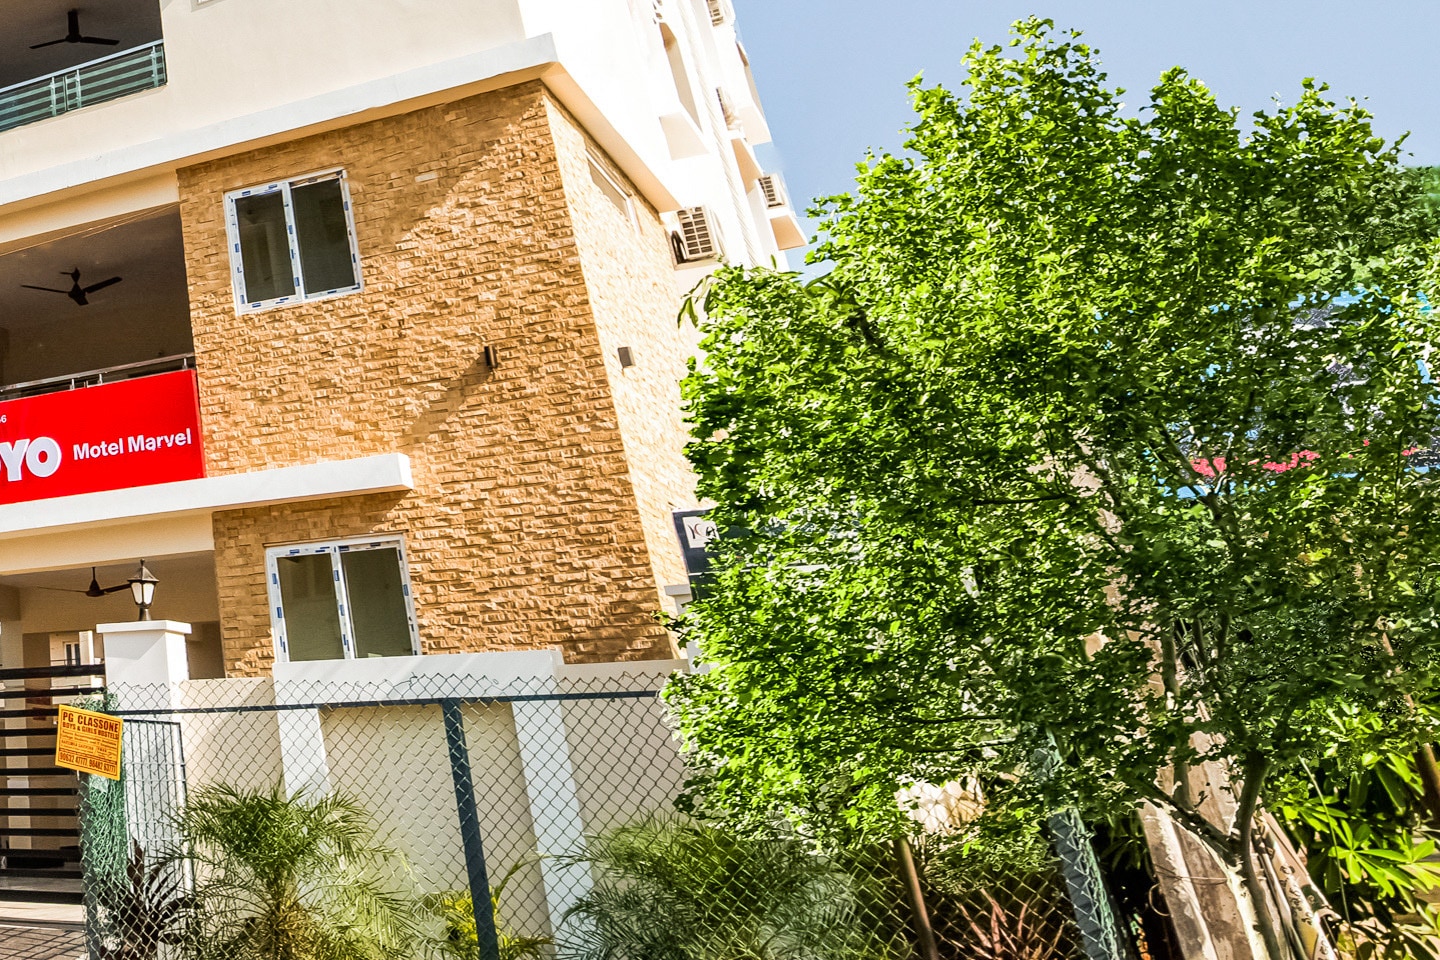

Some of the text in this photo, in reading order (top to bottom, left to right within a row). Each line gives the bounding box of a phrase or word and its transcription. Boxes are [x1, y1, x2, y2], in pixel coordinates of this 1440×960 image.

[73, 428, 192, 460] Motel Marvel
[62, 712, 118, 733] PG CLASSONE
[62, 722, 76, 730] BOYS
[81, 725, 97, 735] GIRLS
[97, 729, 119, 740] HOSTELS
